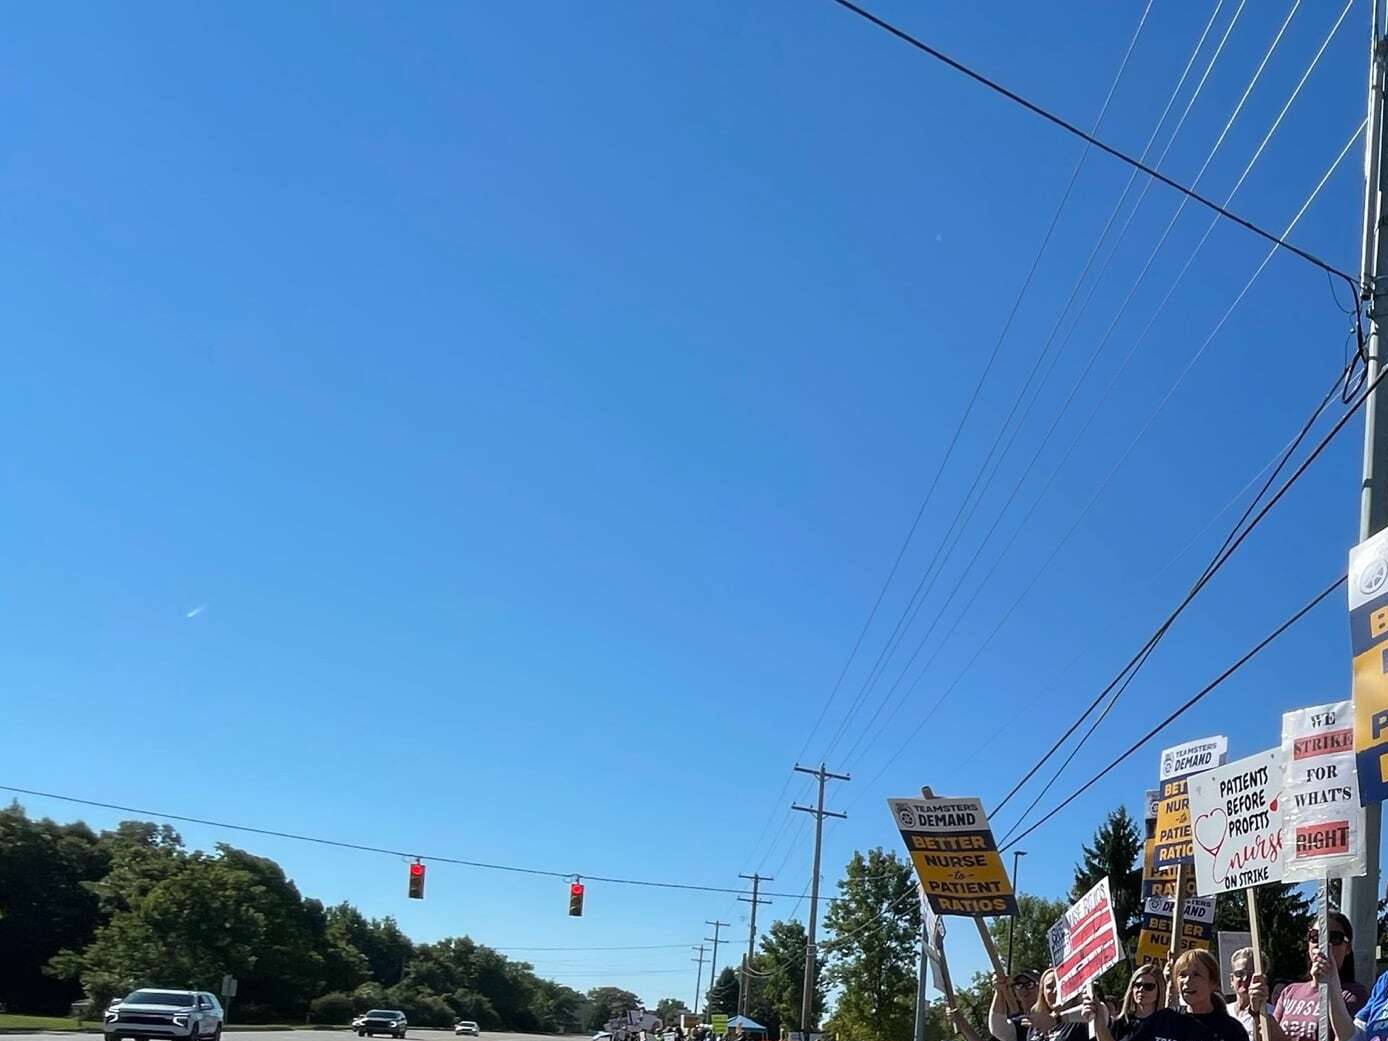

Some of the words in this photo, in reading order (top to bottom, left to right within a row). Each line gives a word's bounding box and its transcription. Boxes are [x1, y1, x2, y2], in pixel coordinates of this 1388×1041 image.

[1311, 711, 1336, 729] WE
[1175, 742, 1217, 759] TEAMSTERS
[1294, 731, 1353, 756] STRIKE
[1174, 753, 1212, 772] DEMAND
[1220, 765, 1269, 798] PATIENTS
[1306, 764, 1338, 782] FOR
[1164, 779, 1187, 797] BET
[1295, 786, 1352, 808] WHAT'S
[913, 804, 978, 813] TEAMSTERS
[1165, 800, 1190, 814] NUR
[1227, 789, 1266, 817] BEFORE
[918, 813, 976, 827] DEMAND
[1228, 810, 1270, 838] PROFITS
[1159, 824, 1192, 842] PATIE
[1296, 826, 1350, 853] RIGHT
[911, 835, 986, 850] BETTER
[924, 855, 988, 868] NURSE
[1159, 844, 1194, 861] RATIO
[1224, 876, 1238, 889] ON
[1238, 866, 1270, 887] STRIKE
[928, 881, 1001, 894] PATIENT
[938, 898, 1007, 912] RATIOS
